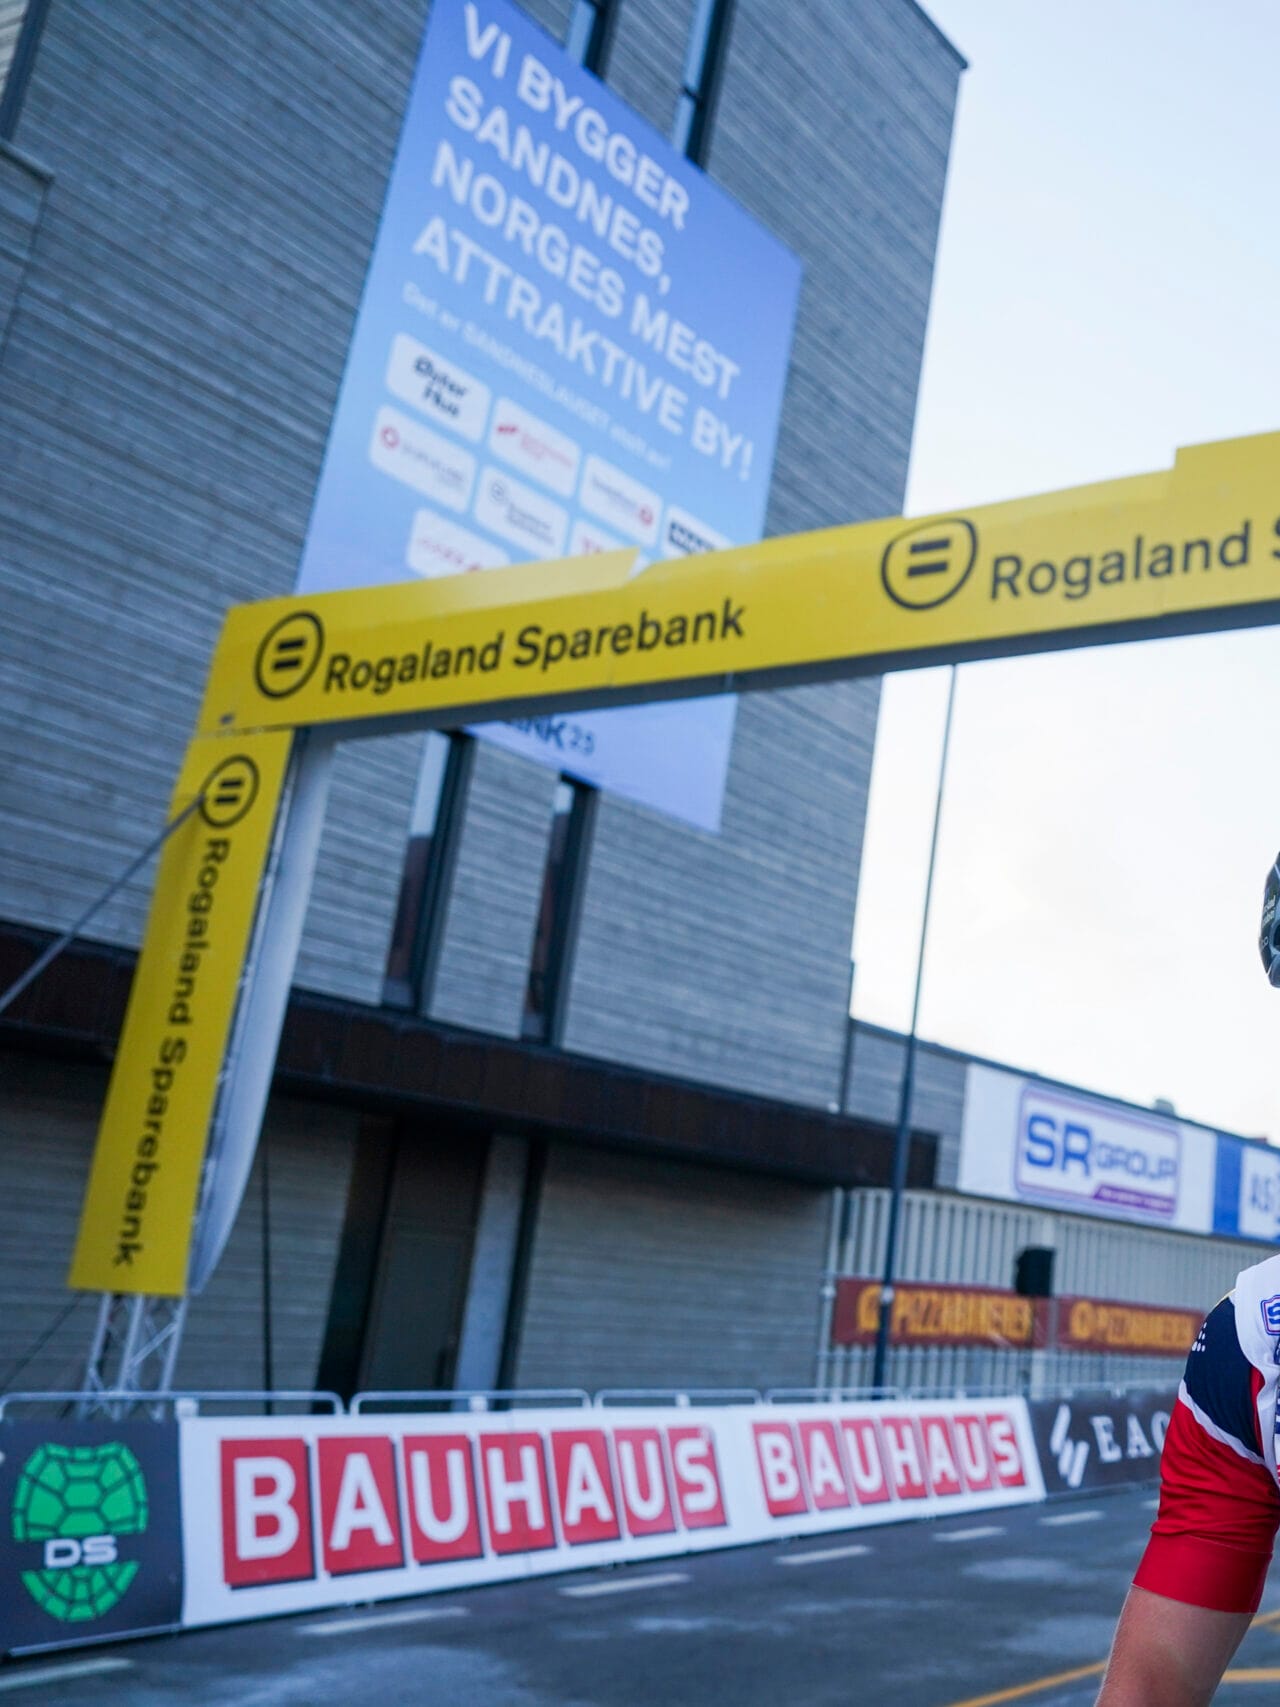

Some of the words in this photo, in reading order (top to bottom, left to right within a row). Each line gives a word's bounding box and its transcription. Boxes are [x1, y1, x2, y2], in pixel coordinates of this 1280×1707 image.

[446, 76, 670, 294] SANDNES,
[464, 2, 511, 78] VI
[517, 55, 691, 231] BYGGER
[412, 217, 689, 435] ATTRAKTIVE
[692, 406, 754, 482] BY!
[432, 140, 626, 317] NORGES
[631, 294, 740, 399] MEST
[323, 632, 505, 695] Rogaland
[512, 597, 746, 671] Sparebank
[989, 520, 1251, 601] Rogaland
[166, 838, 231, 1029] Rogaland
[114, 1037, 188, 1269] Sparebank
[1026, 1112, 1093, 1178] SR
[44, 1534, 118, 1569] DS
[230, 1440, 720, 1562] BAUHAUS
[757, 1420, 1022, 1503] BAUHAUS
